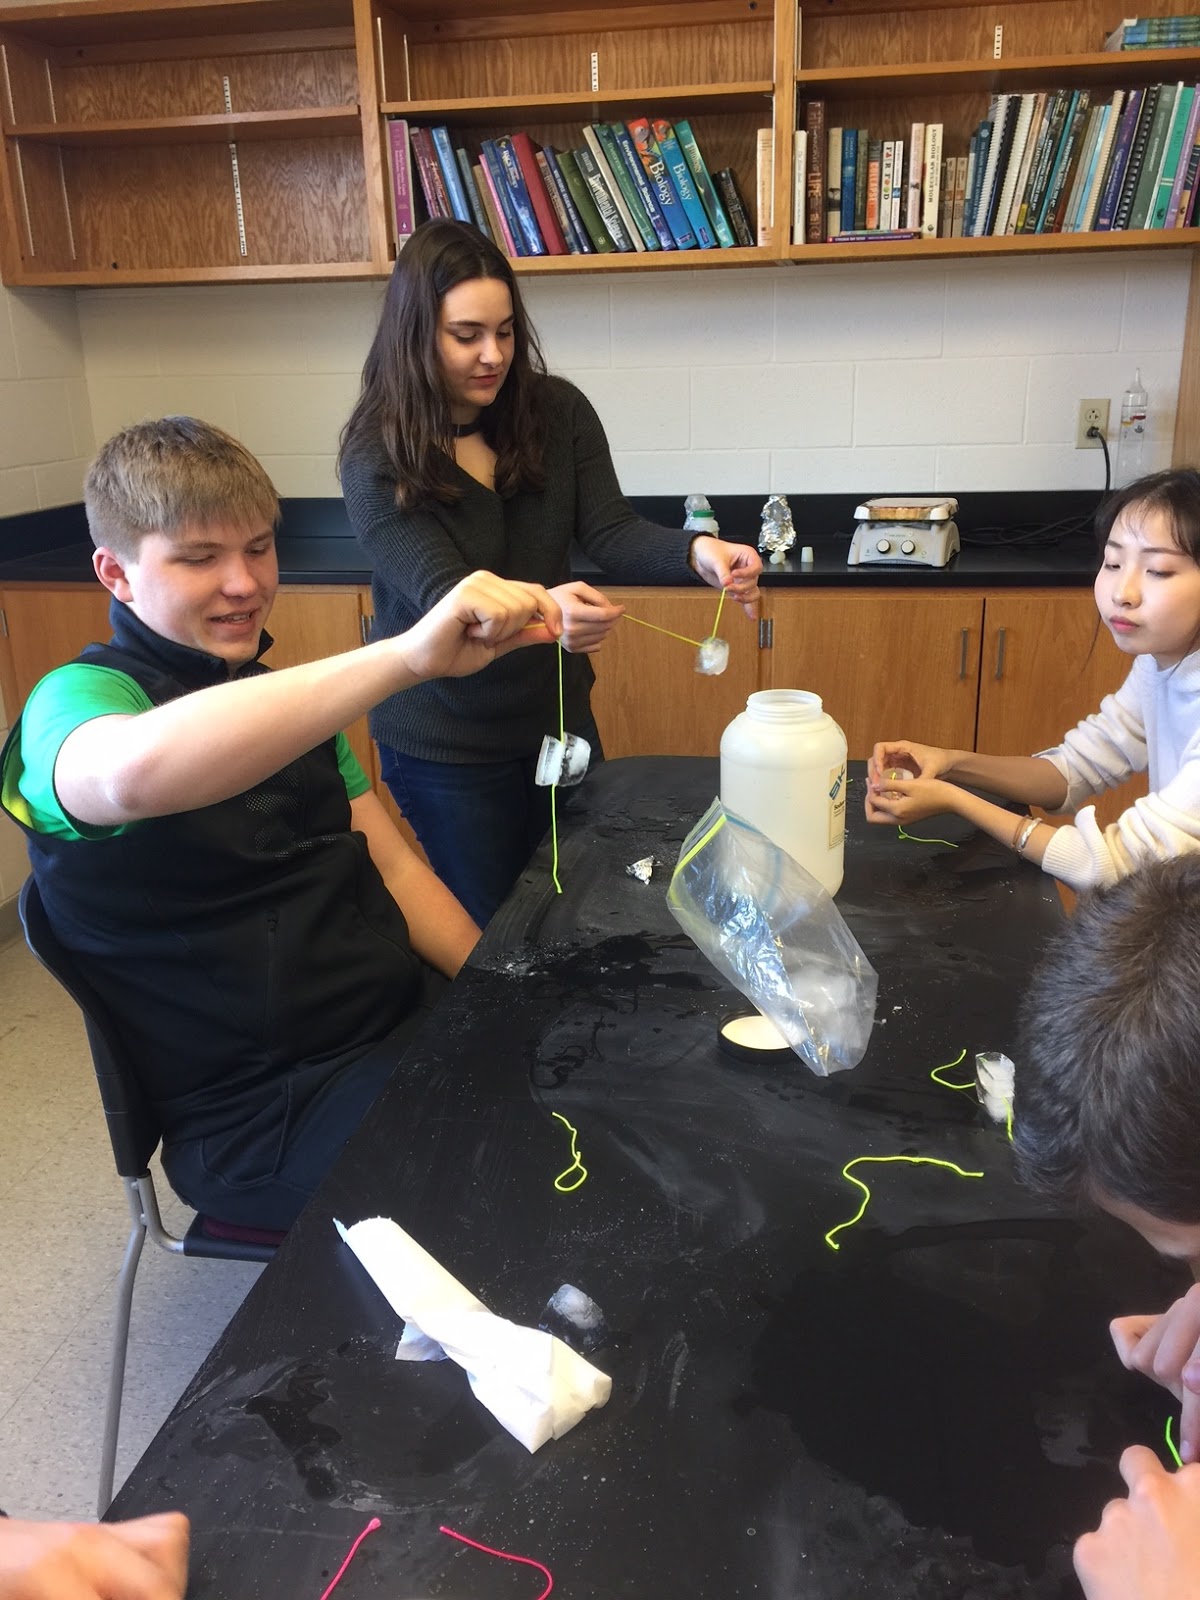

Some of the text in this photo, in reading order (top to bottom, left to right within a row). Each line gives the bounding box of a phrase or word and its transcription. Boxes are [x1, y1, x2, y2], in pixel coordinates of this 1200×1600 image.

[606, 141, 625, 175] Environment
[687, 145, 703, 174] Biology
[1039, 139, 1052, 174] ENVIRONMENTAL
[1059, 135, 1074, 172] ENVIRONMENTAL
[1147, 137, 1159, 171] ENVIRONMENT
[507, 166, 519, 189] Biology
[556, 178, 566, 192] PEOPLE
[621, 139, 645, 186] Environmental
[640, 186, 656, 213] Science
[648, 159, 677, 208] Biology
[671, 161, 695, 202] Biology
[807, 172, 821, 197] LIFE
[867, 162, 877, 201] COLLAPSE
[1035, 175, 1043, 193] SCIENCE
[587, 172, 626, 240] Environmental Science
